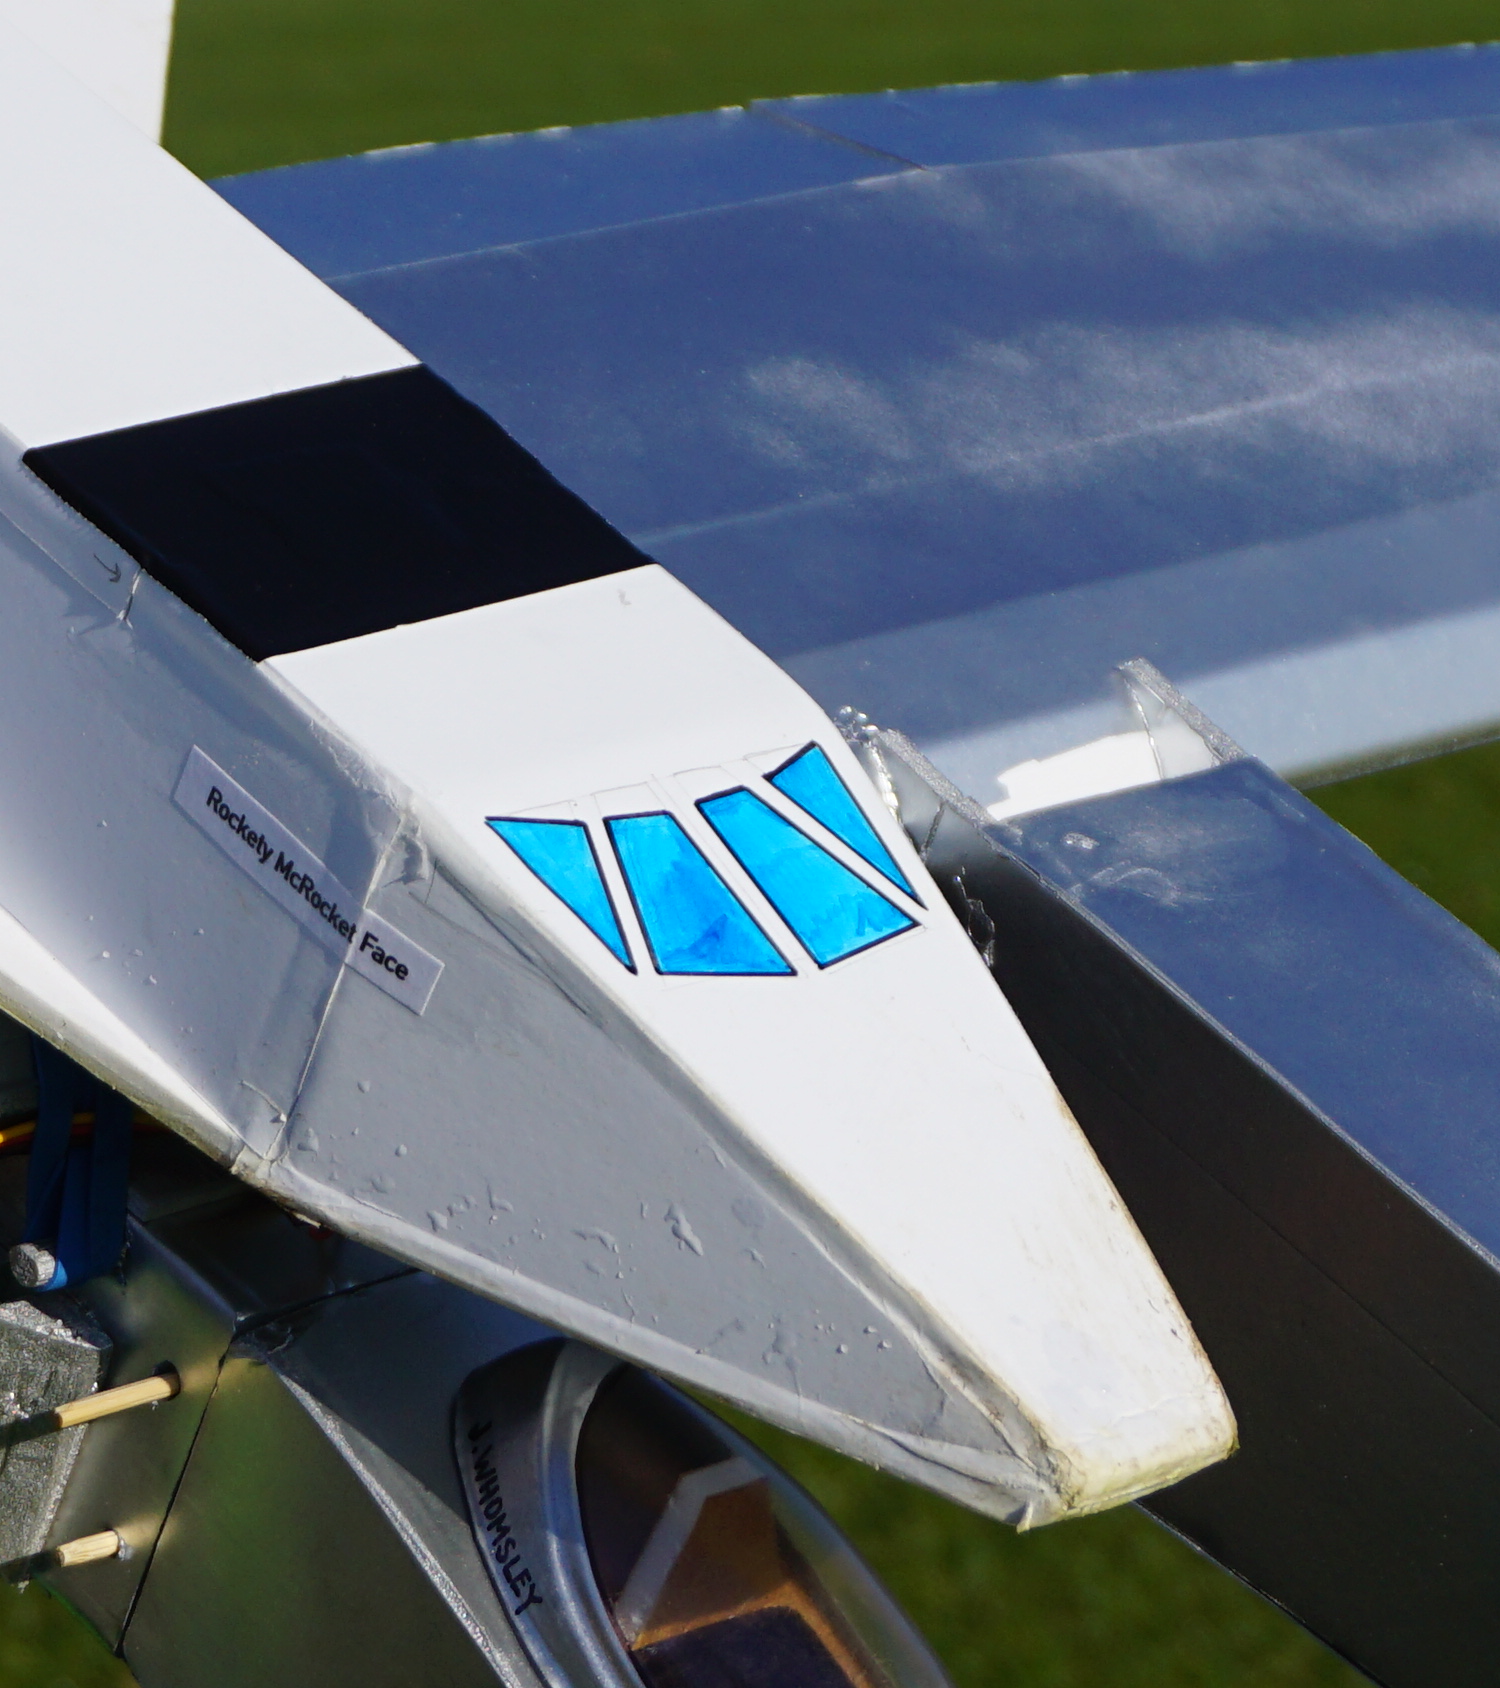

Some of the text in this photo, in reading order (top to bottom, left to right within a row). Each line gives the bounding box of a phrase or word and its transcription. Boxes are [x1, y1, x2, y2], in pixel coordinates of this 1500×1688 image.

[206, 786, 409, 981] Rockety McRocket Face
